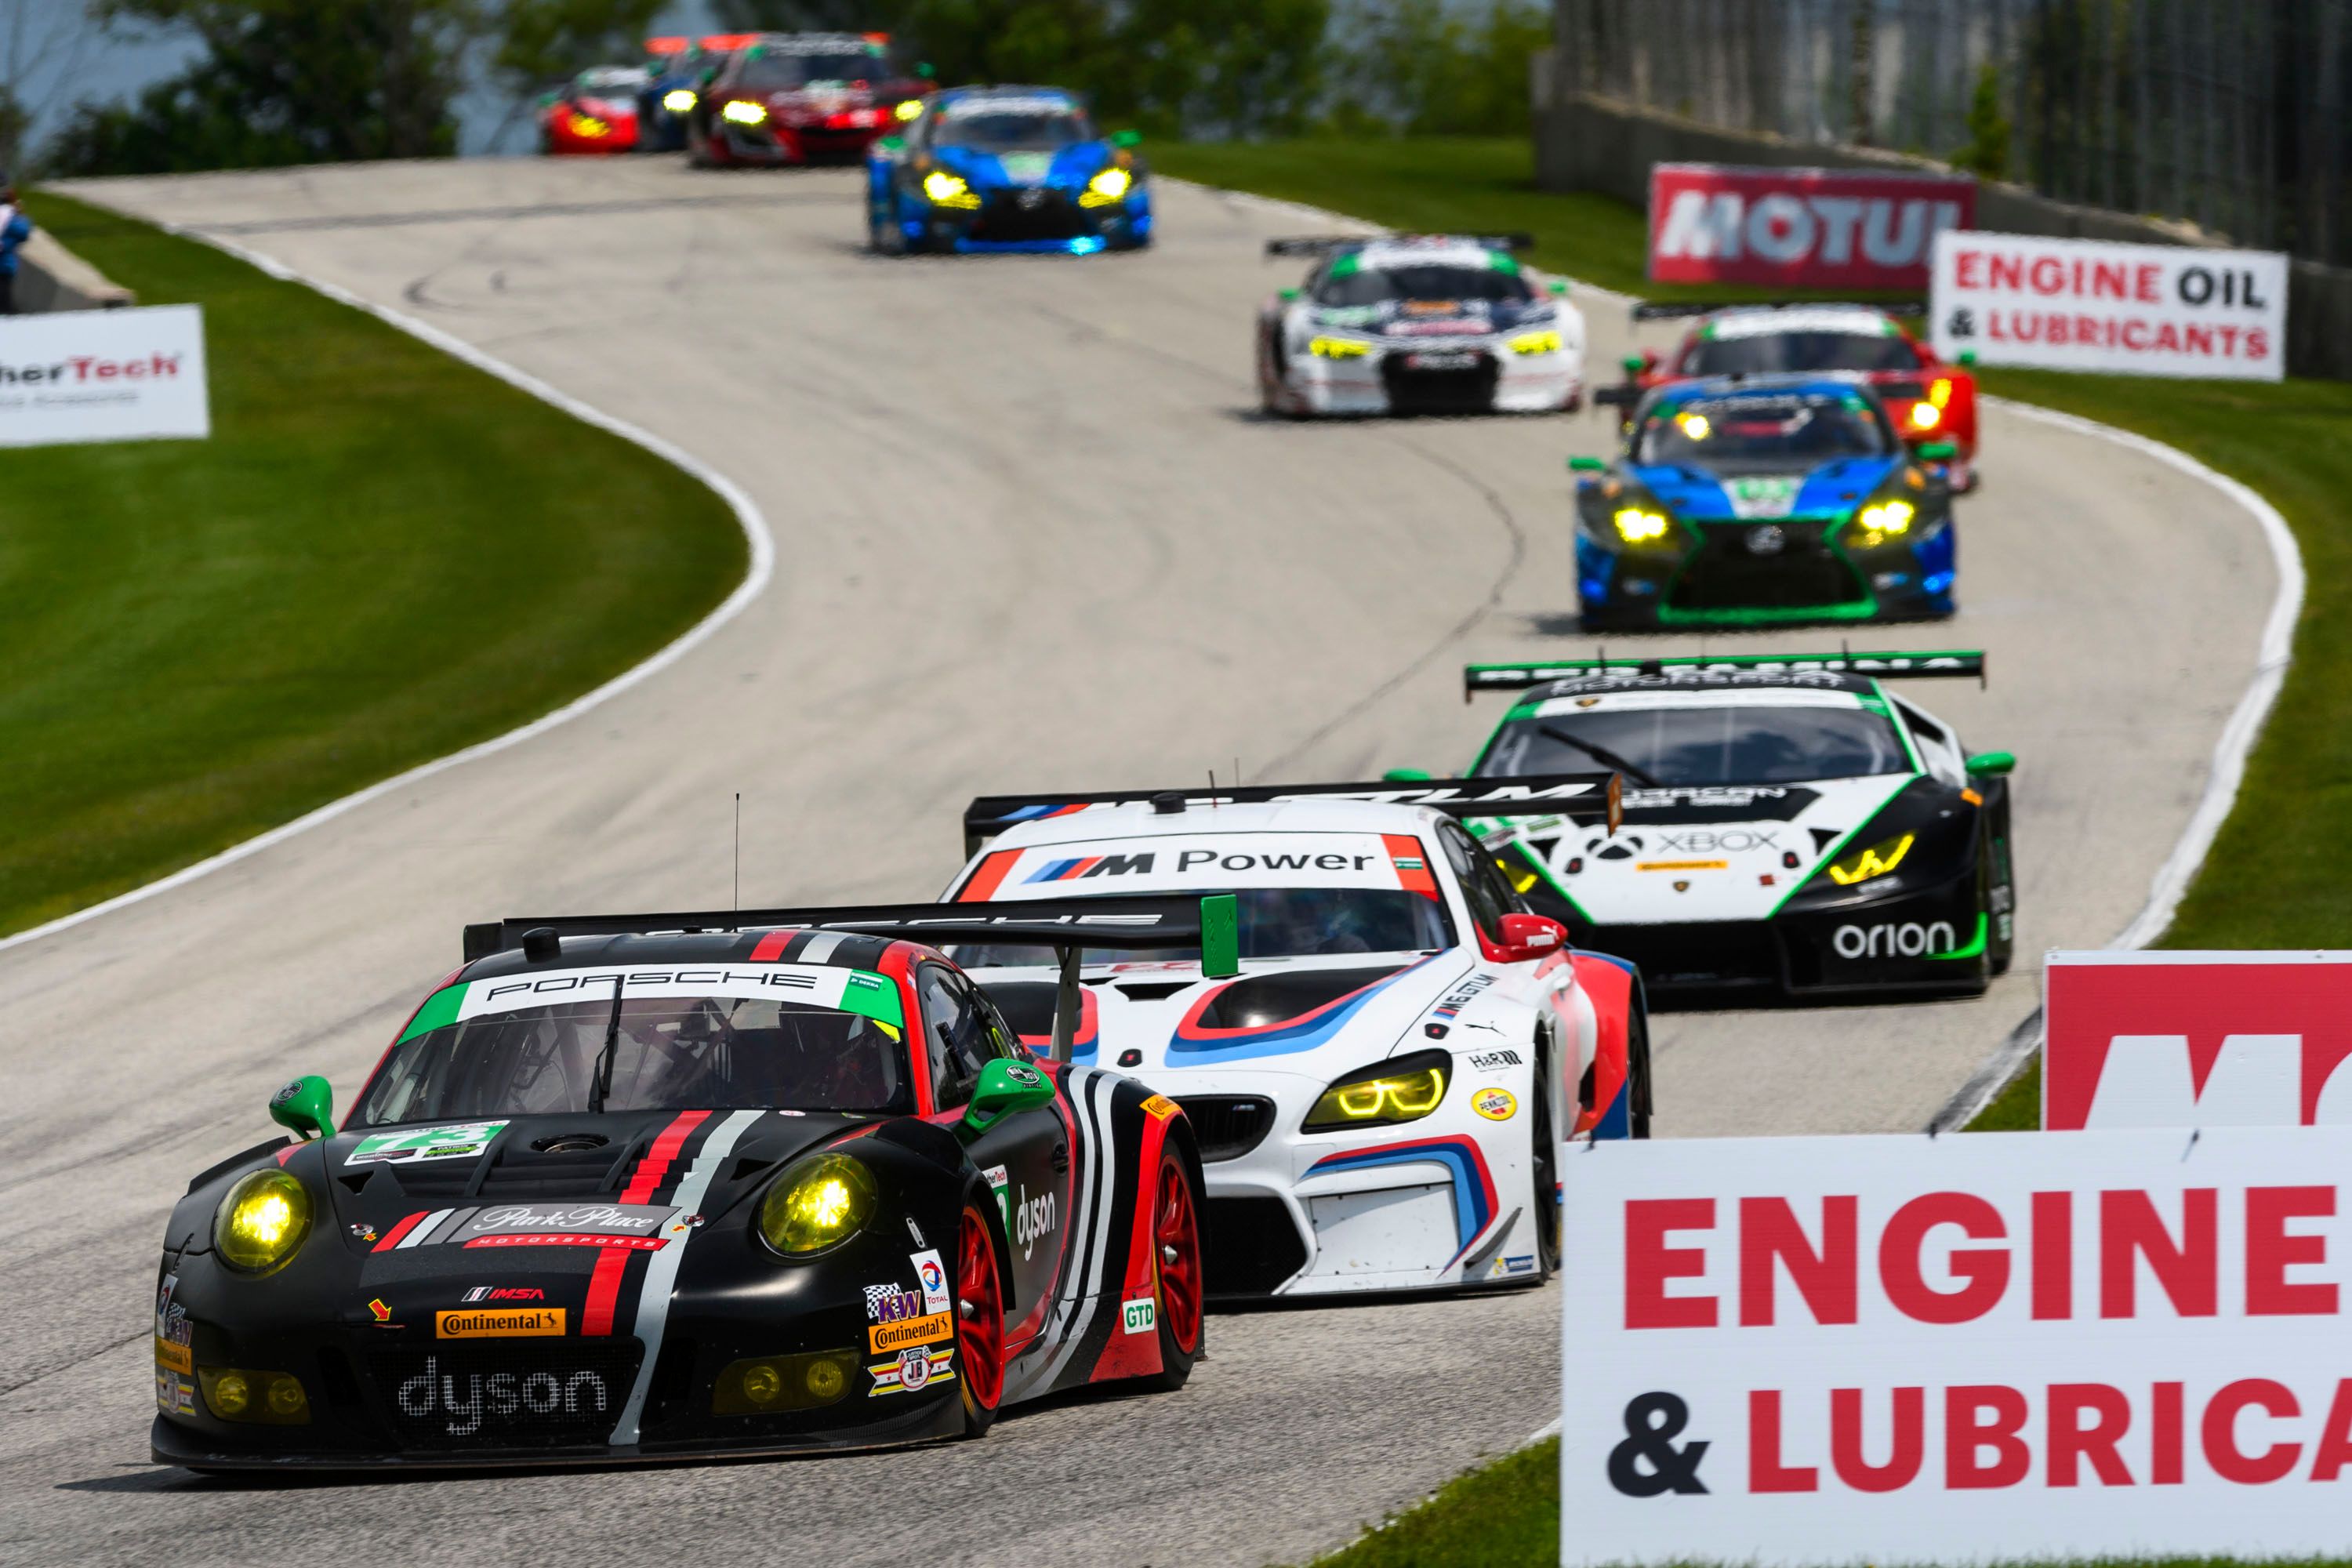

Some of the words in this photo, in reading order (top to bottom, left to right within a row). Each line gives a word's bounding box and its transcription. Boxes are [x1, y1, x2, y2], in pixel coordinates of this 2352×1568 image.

[1954, 250, 2162, 303] ENGINE
[2178, 266, 2266, 310] OIL
[1949, 309, 1974, 339] &
[1987, 311, 2269, 360] LUBRICANTS
[1657, 831, 1779, 853] XBOX
[1178, 850, 1375, 873] Power
[1833, 920, 1955, 959] orion
[486, 971, 818, 1002] PORSCHE
[374, 1127, 490, 1152] 73
[473, 1207, 562, 1231] Park
[560, 1206, 654, 1229] Place
[1017, 1184, 1055, 1261] dyson
[477, 1236, 657, 1247] MOTORSPORTS
[1623, 1185, 2339, 1330] ENGINE
[488, 1288, 544, 1300] IMSA
[878, 1290, 921, 1324] KW
[927, 1295, 948, 1305] TOTAL
[442, 1312, 541, 1335] Continental
[1126, 1304, 1154, 1328] GTD
[875, 1318, 940, 1349] Continental
[399, 1356, 607, 1436] dyson
[1606, 1392, 1712, 1499] &
